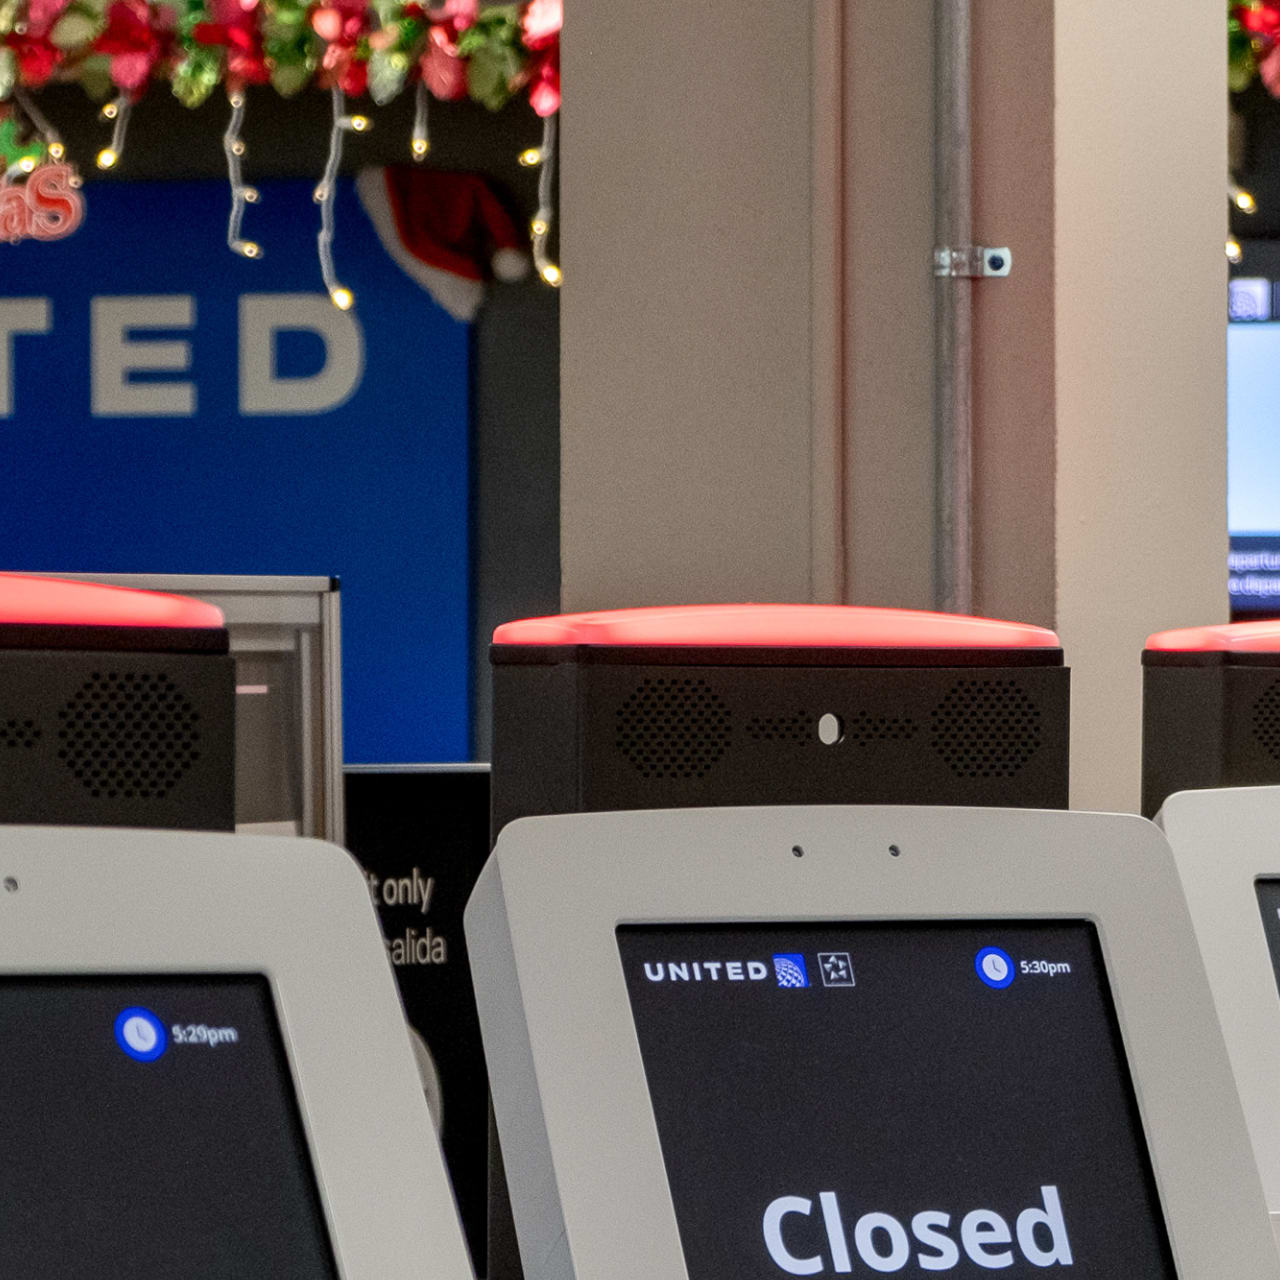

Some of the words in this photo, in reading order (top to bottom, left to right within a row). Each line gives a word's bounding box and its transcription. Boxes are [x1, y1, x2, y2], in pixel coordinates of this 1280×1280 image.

[382, 868, 433, 914] only
[644, 960, 768, 982] UNITED
[1019, 960, 1072, 977] 5:30pm
[171, 1023, 238, 1048] 5:29pm
[762, 1185, 1074, 1276] Closed
